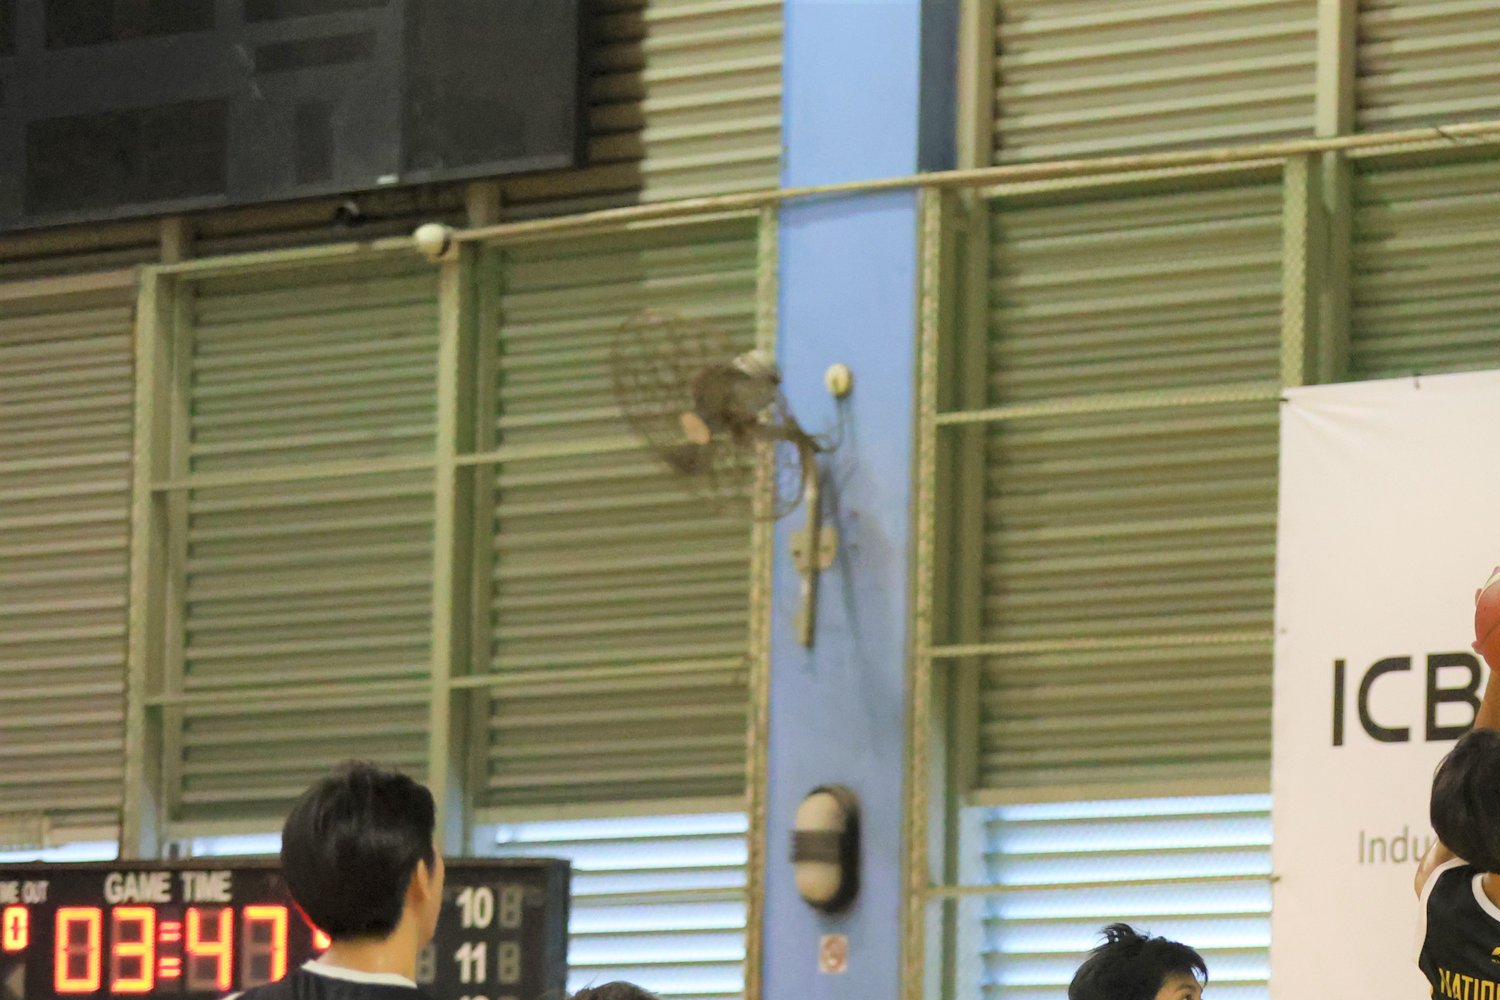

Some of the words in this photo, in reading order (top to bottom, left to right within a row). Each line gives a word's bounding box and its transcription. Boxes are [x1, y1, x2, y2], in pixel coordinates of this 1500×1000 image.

[104, 872, 172, 903] GAME
[181, 870, 233, 902] TIME
[456, 886, 494, 929] 10
[54, 905, 289, 994] 03:47
[454, 941, 487, 984] 11
